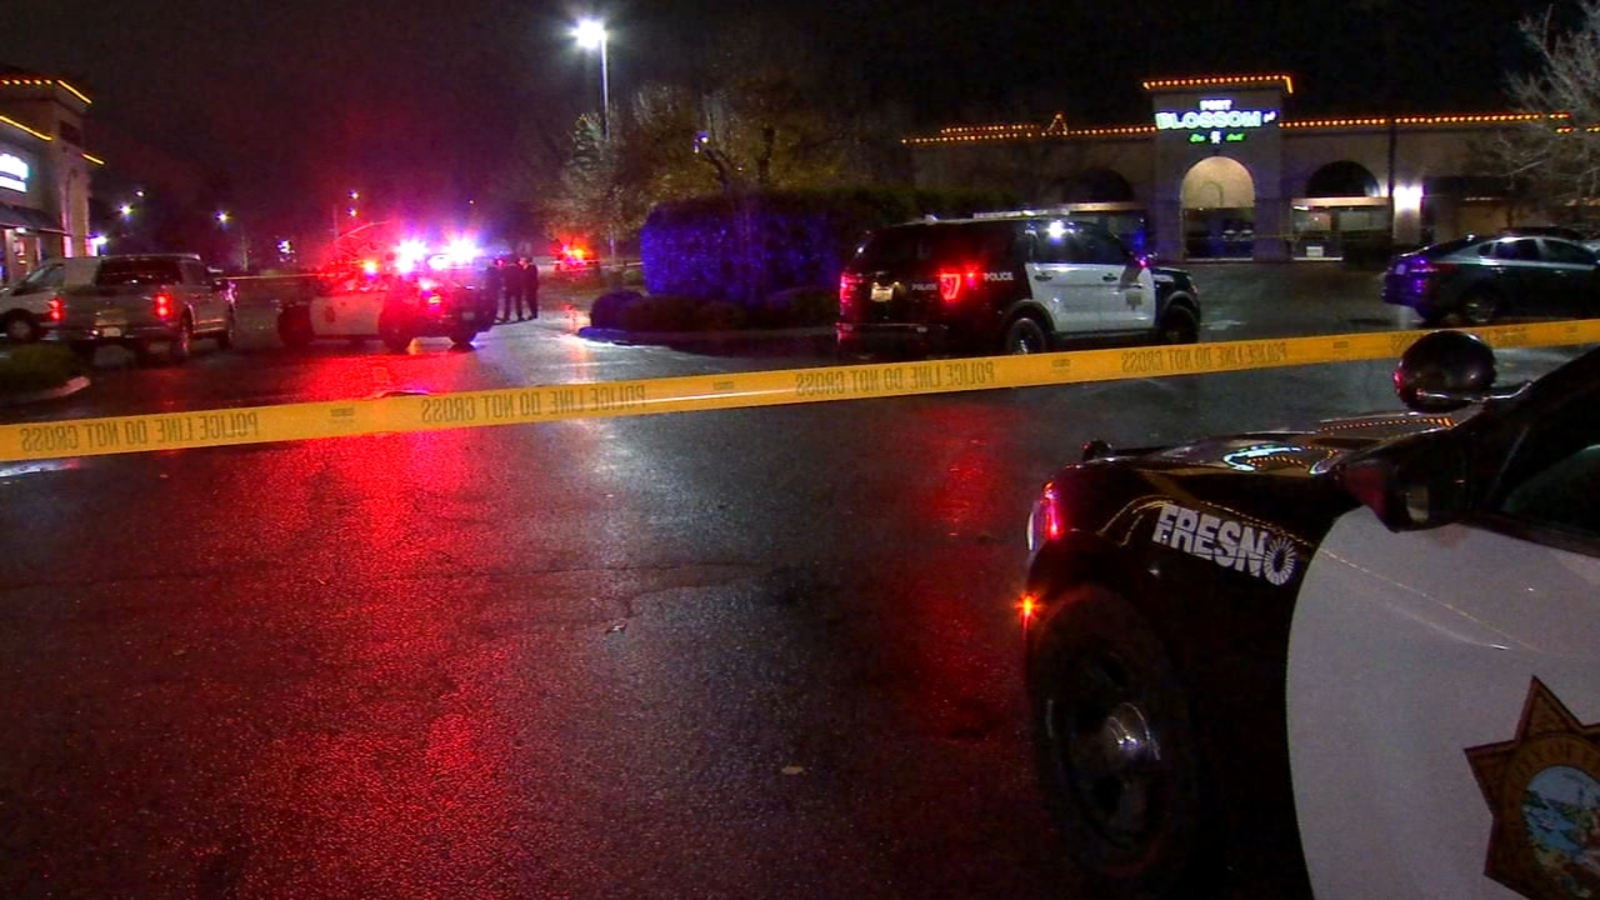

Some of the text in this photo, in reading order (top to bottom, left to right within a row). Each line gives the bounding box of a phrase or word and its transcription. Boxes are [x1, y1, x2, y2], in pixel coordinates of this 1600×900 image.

[1155, 111, 1262, 130] BLOSSOM
[985, 271, 1014, 281] POLICE
[1152, 503, 1297, 585] FRESNO
